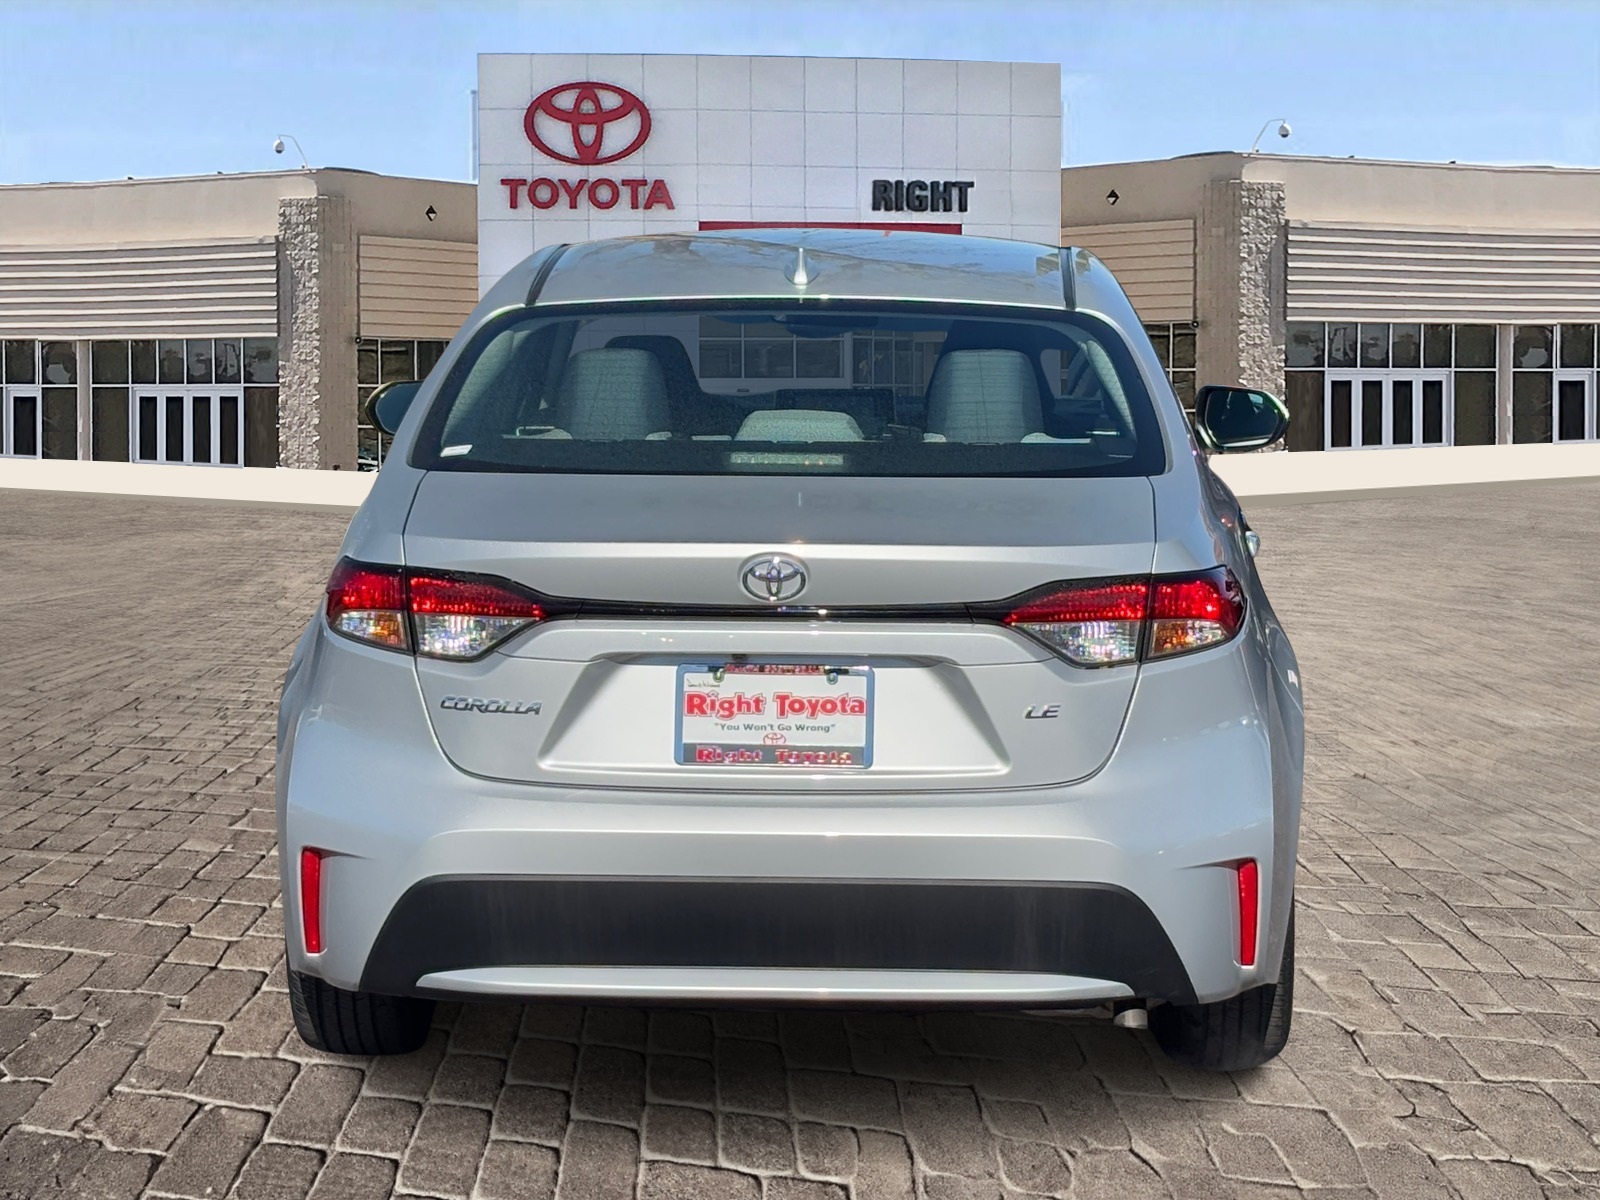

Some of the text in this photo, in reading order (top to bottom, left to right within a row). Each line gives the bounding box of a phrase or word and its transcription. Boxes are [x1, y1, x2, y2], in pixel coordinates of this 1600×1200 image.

[500, 177, 675, 210] TOYOTA
[872, 179, 975, 212] RIGHT
[440, 695, 543, 715] COROLLA
[685, 691, 866, 720] Right Toyota
[1025, 704, 1061, 719] LE
[743, 722, 775, 731] Won't
[777, 723, 792, 731] Go
[696, 747, 852, 764] Right Toyota
